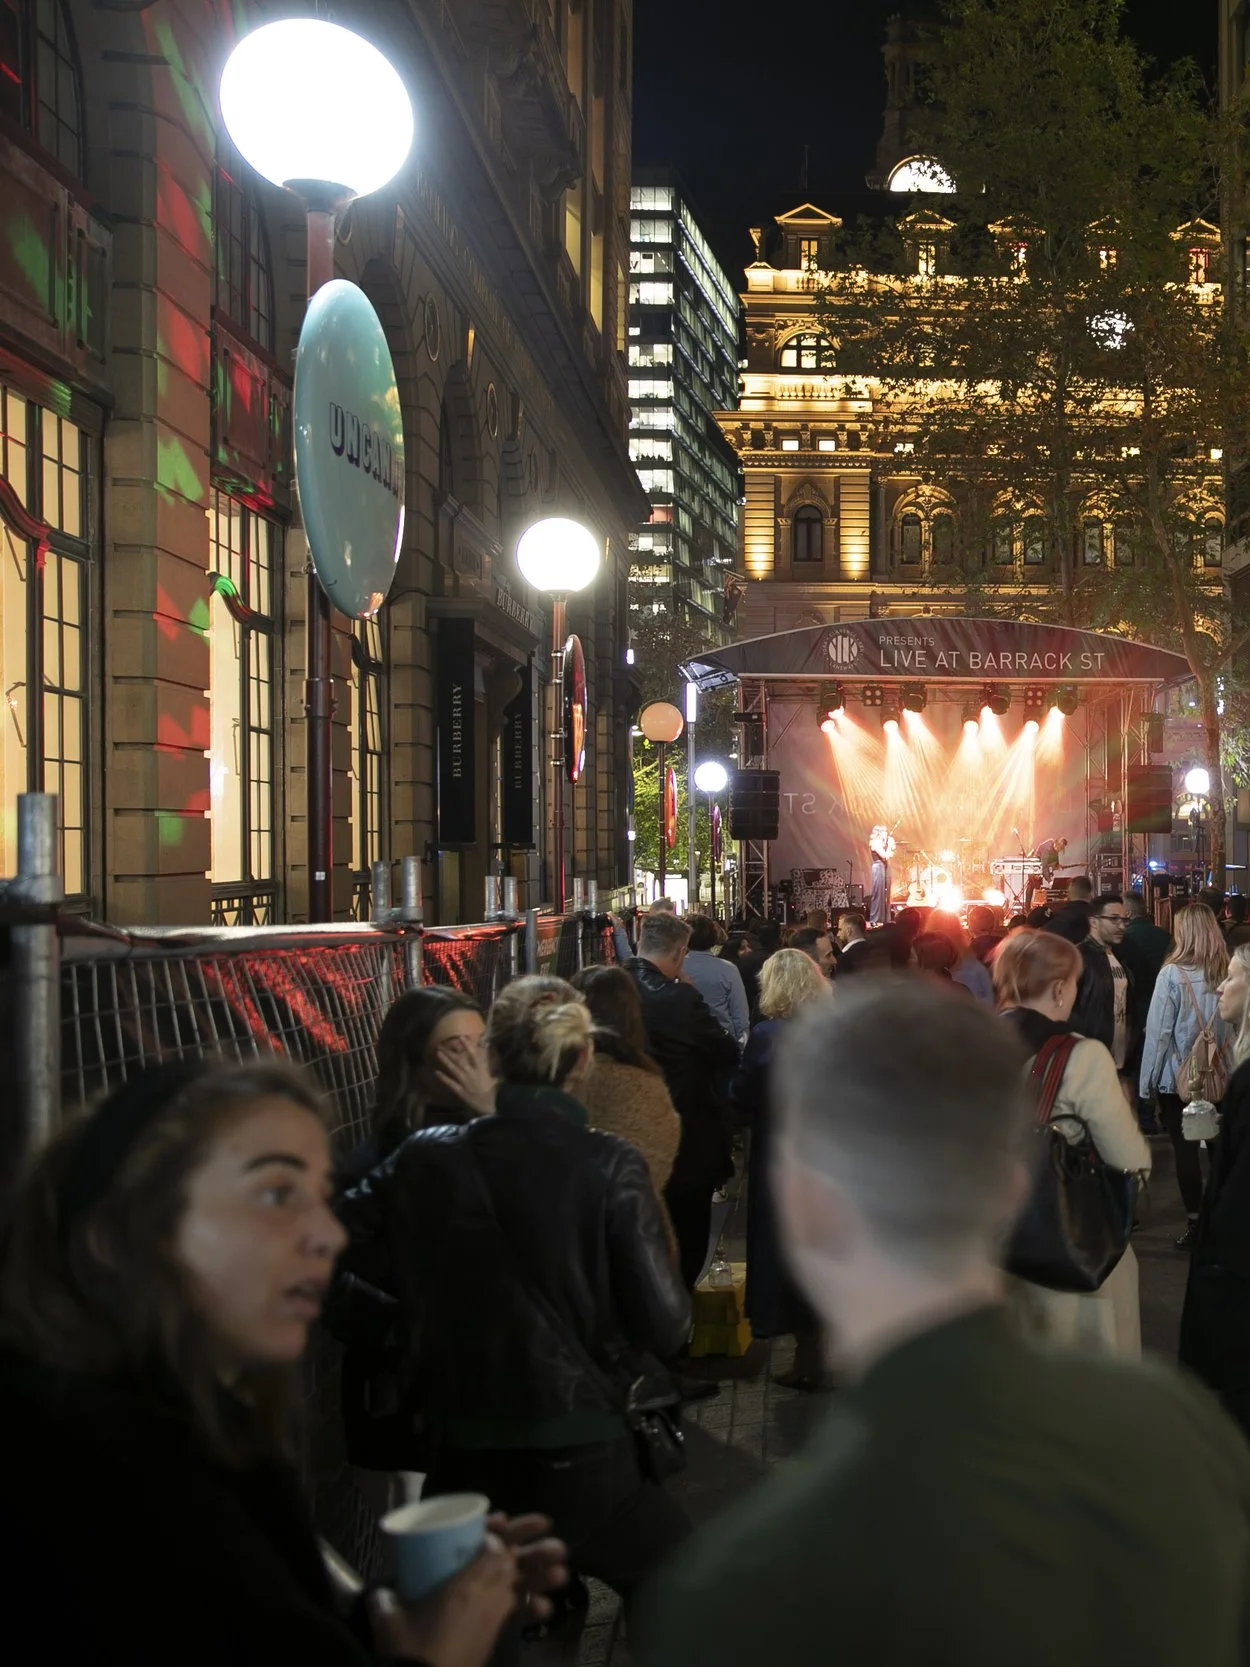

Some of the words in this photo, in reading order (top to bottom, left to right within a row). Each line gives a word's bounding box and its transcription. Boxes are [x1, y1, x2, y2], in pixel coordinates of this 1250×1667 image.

[330, 402, 402, 500] UNCANN
[879, 635, 935, 647] PRESENTS
[880, 649, 927, 668] LIVE
[935, 651, 961, 669] AT
[969, 652, 1073, 670] BARRACK
[1080, 653, 1105, 670] ST
[452, 682, 462, 777] BURBERRY
